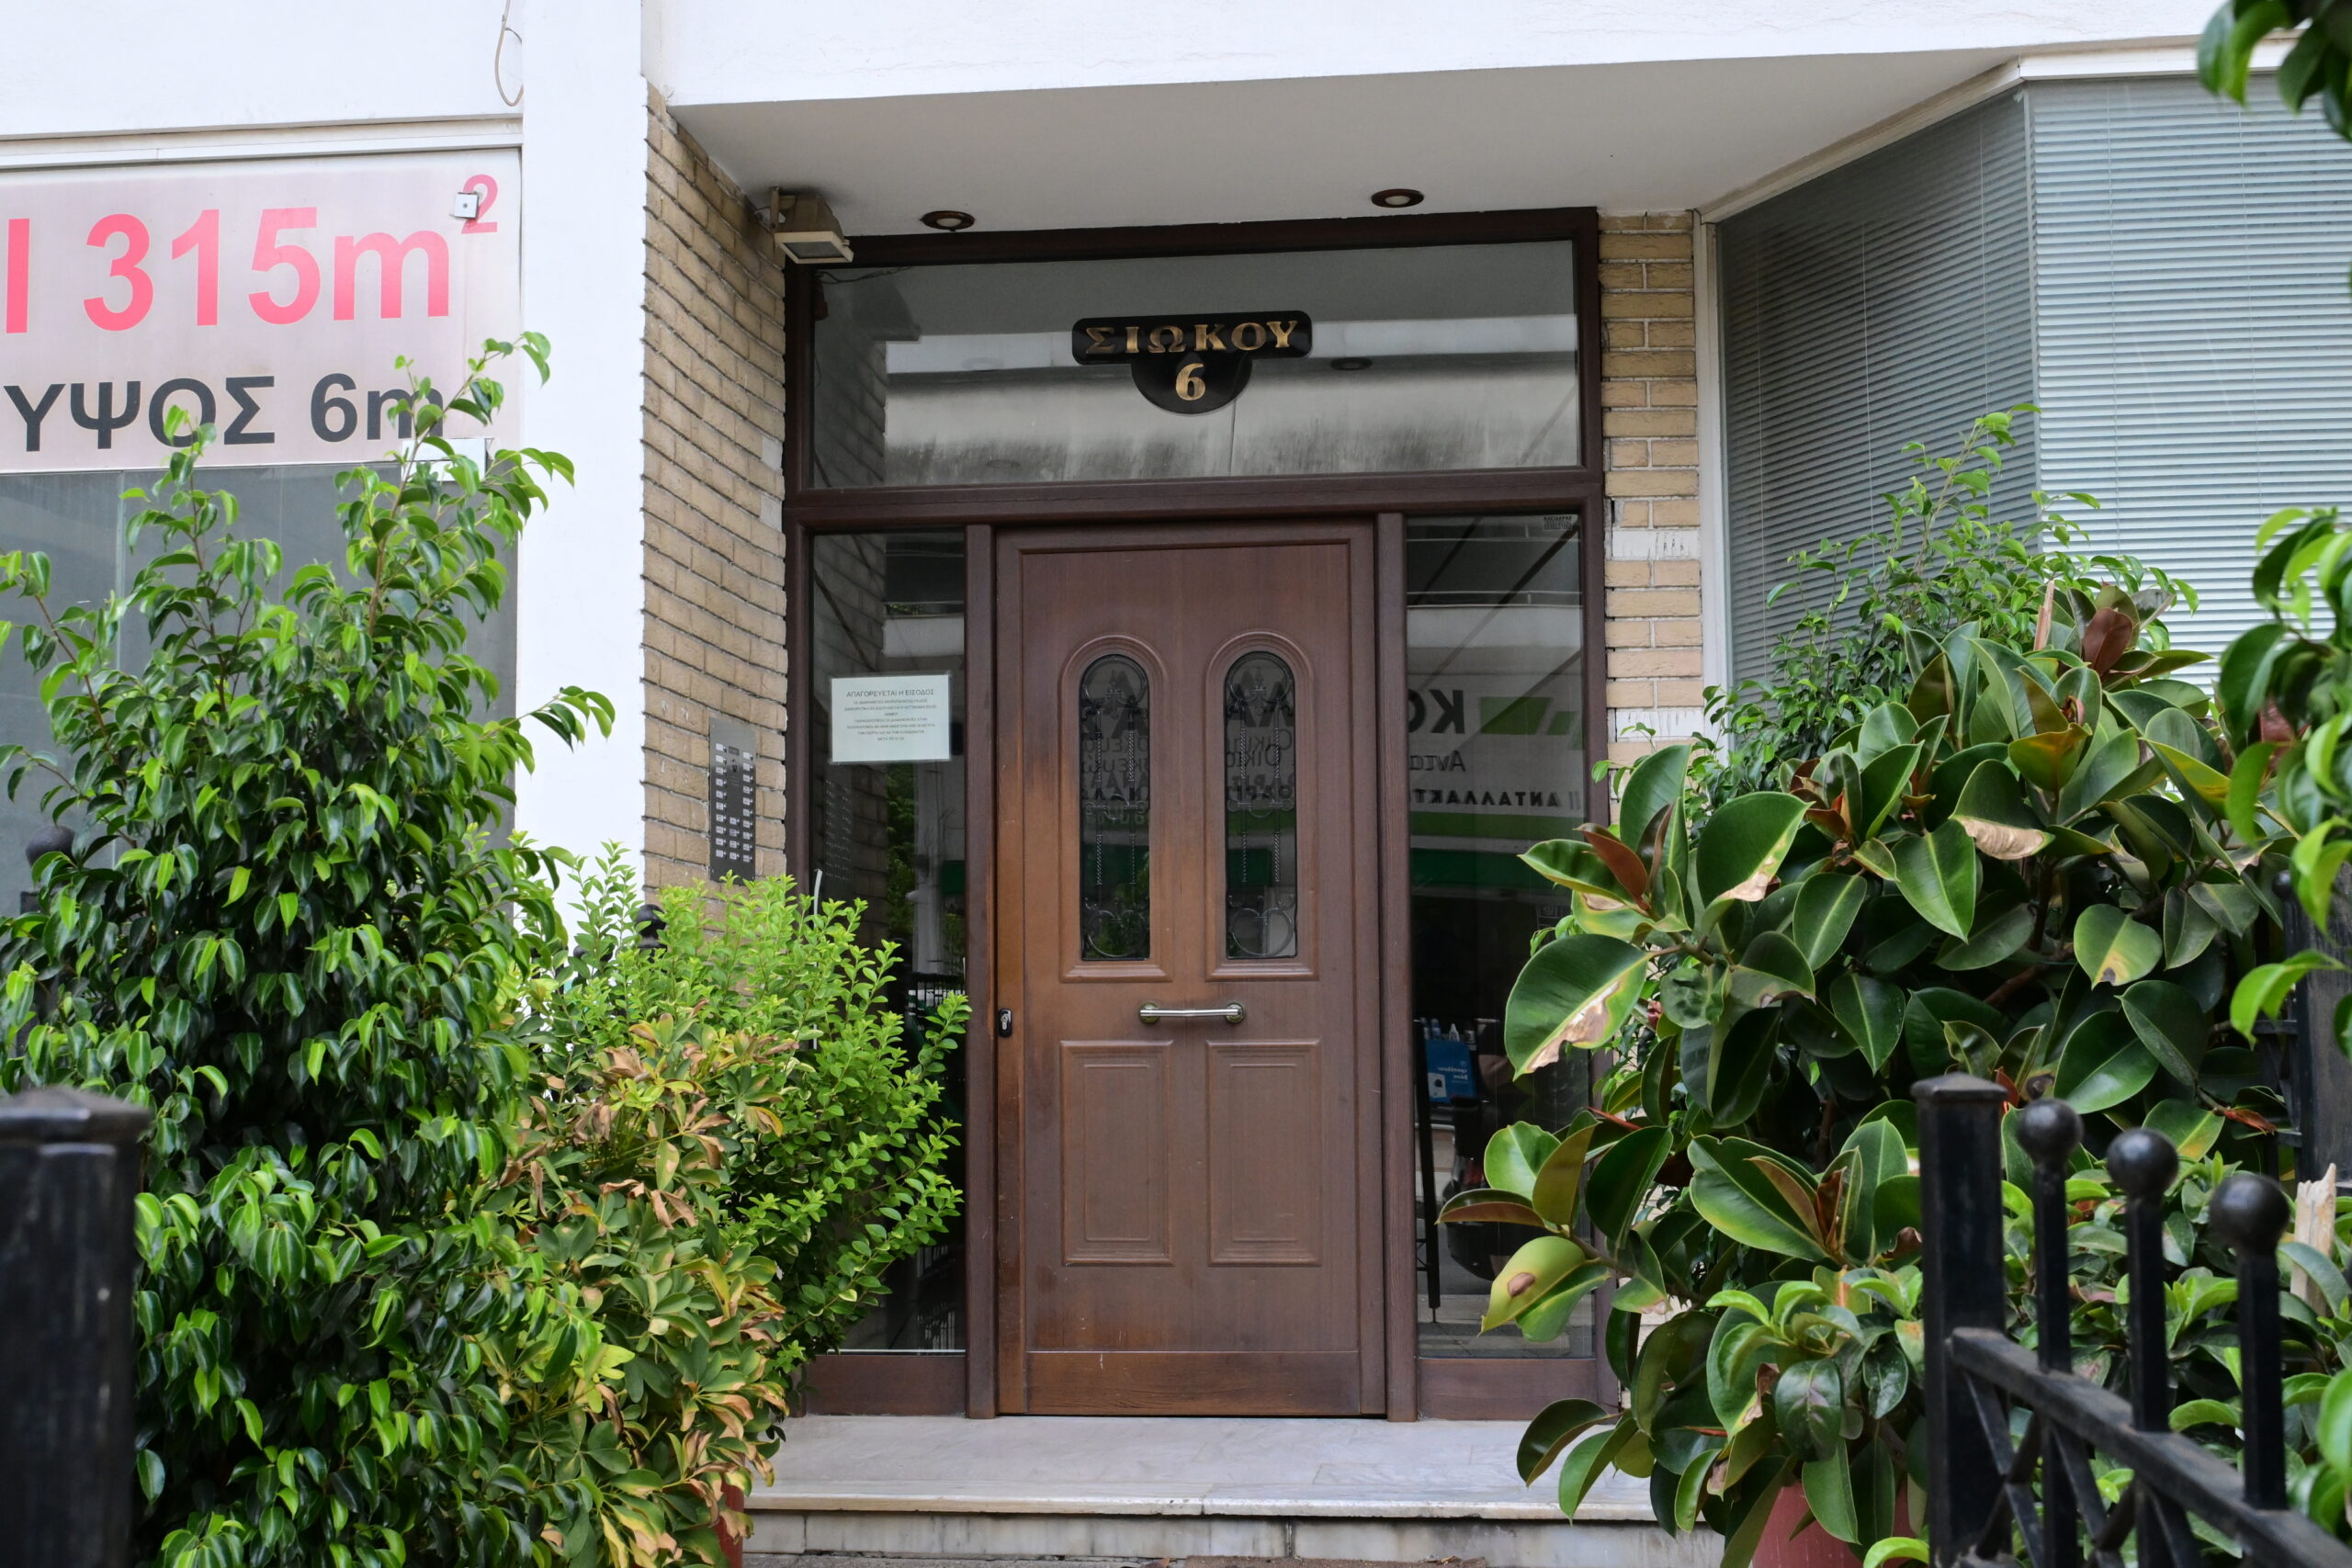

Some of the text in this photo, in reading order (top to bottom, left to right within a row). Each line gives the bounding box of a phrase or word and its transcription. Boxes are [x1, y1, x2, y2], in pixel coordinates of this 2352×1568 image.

[1085, 321, 1298, 355] ΣΙΩΚΟΥ
[1175, 363, 1206, 401] 6
[3, 375, 275, 452] ΥΨΟΣ
[846, 690, 898, 698] ΑΠΑΓΟΡΕΥΕΤΑΙ
[905, 688, 934, 696] ΕΙΣΟΔΟΣ
